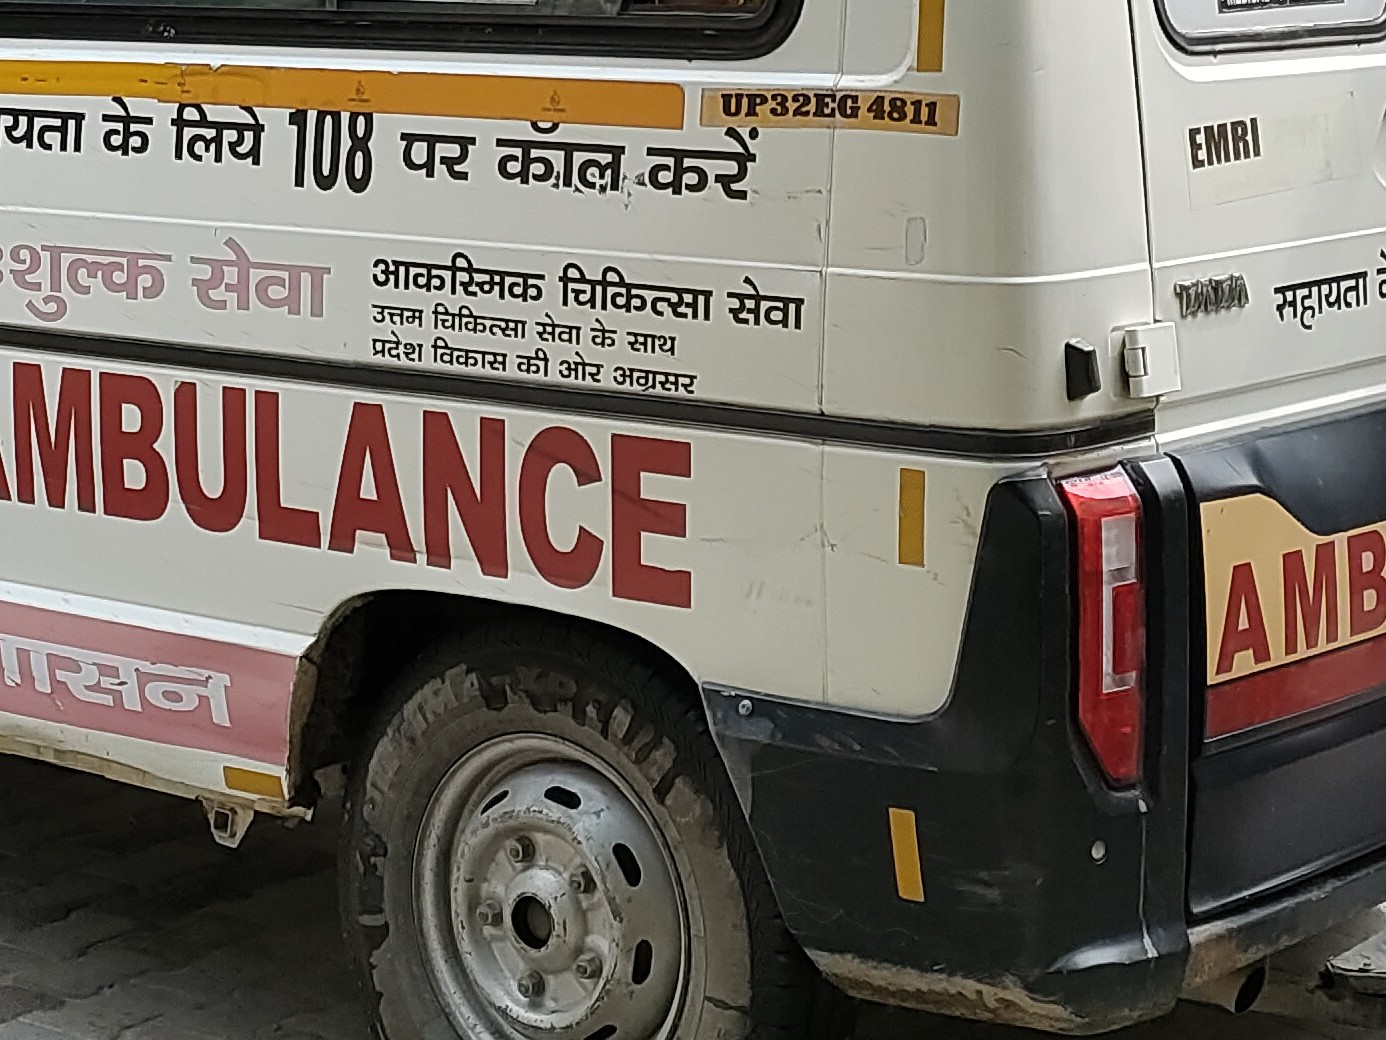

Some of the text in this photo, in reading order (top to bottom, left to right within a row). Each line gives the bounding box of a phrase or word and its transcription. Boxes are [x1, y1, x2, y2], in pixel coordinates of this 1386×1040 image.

[720, 91, 939, 128] UP32EG 4811
[101, 96, 154, 156] के
[170, 103, 265, 166] लिये
[288, 109, 374, 193] 108
[400, 132, 477, 182] पर
[645, 126, 757, 201] करें
[1188, 117, 1262, 170] EMRI
[190, 236, 332, 318] सेवा
[371, 252, 805, 330] आकस्मिक चिकित्सा सेवा
[1274, 270, 1369, 331] सहायता
[371, 302, 677, 357] उत्तम चिकित्सा सेवा के साथ
[371, 329, 698, 396] प्रदेश विकास की ओर अग्रसर
[0, 363, 693, 608] MBULANCE
